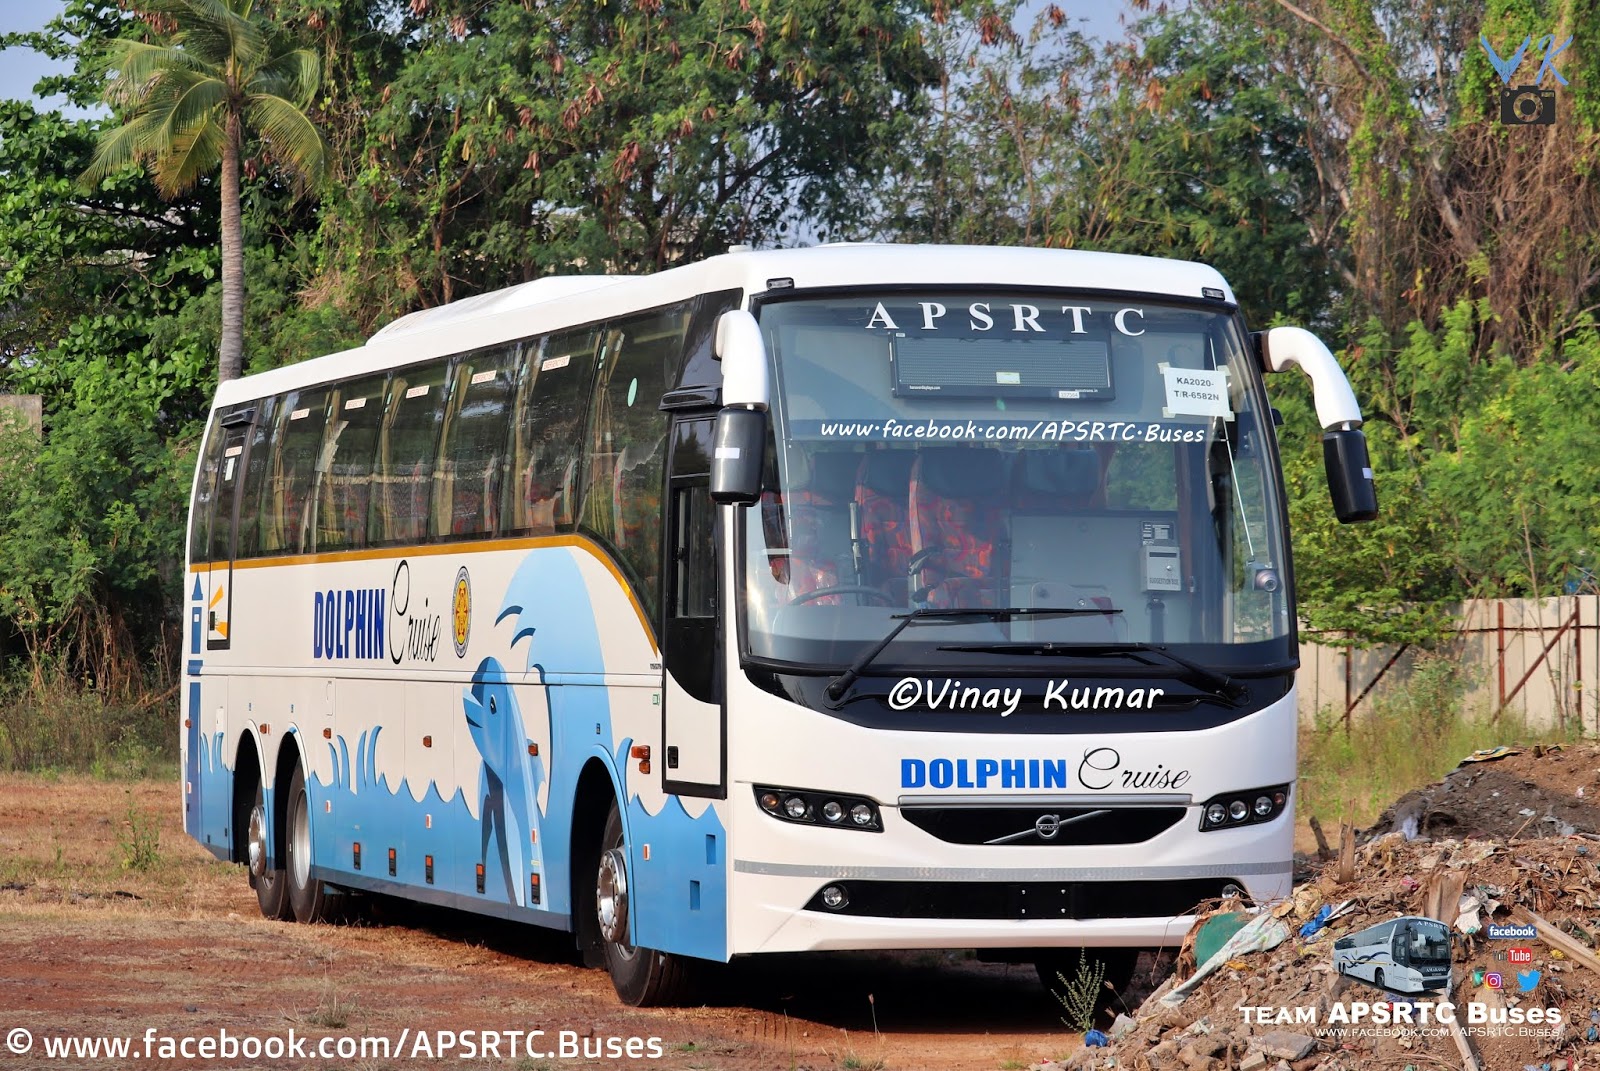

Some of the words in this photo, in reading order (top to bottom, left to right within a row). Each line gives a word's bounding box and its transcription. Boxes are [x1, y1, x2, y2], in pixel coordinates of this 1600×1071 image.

[1176, 377, 1215, 387] KA2020-
[313, 588, 385, 660] DOLPHIN
[388, 559, 442, 665] Cruise
[901, 759, 1067, 788] DOLPHIN
[1078, 747, 1191, 790] Cruise
